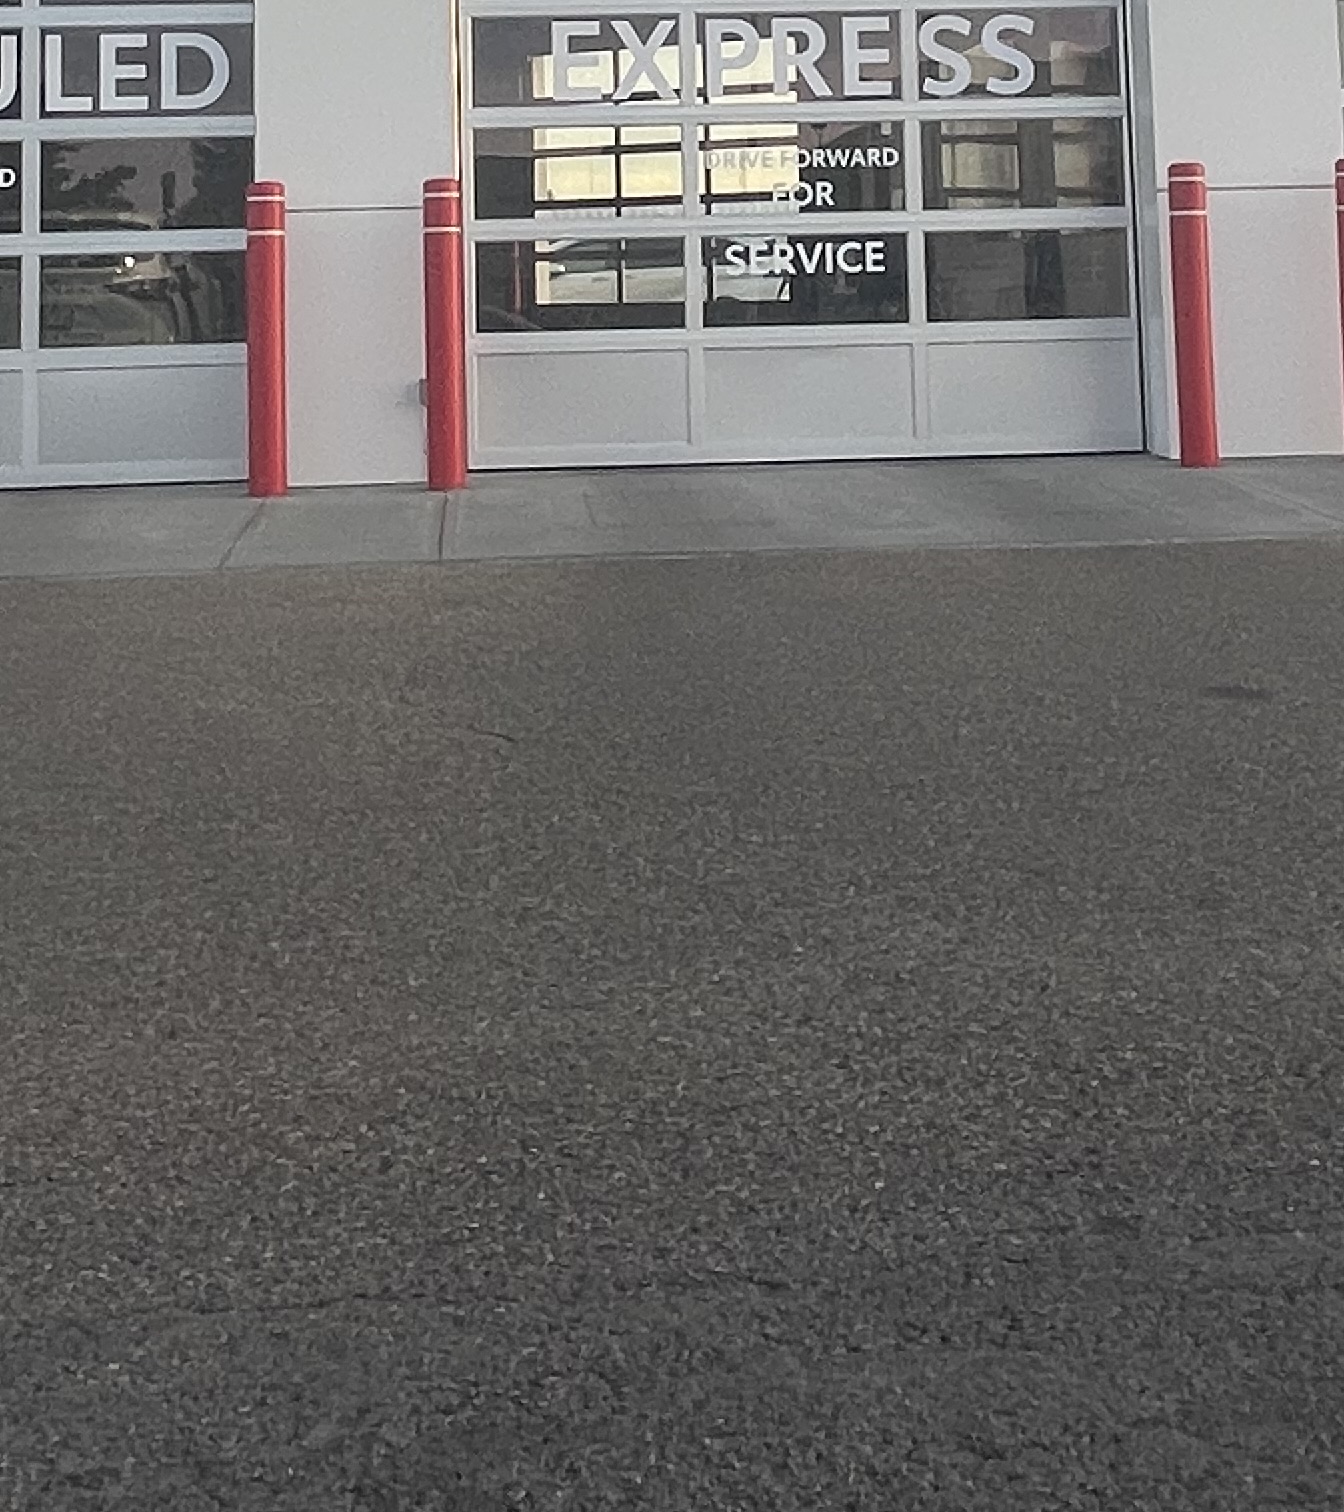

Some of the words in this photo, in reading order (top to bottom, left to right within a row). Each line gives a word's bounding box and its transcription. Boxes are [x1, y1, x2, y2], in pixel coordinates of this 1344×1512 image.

[549, 15, 1036, 102] EXPRESS
[708, 150, 775, 170] DRIVE
[780, 147, 900, 169] FORWARD
[773, 180, 836, 208] FOR
[725, 240, 887, 276] SERVICE
